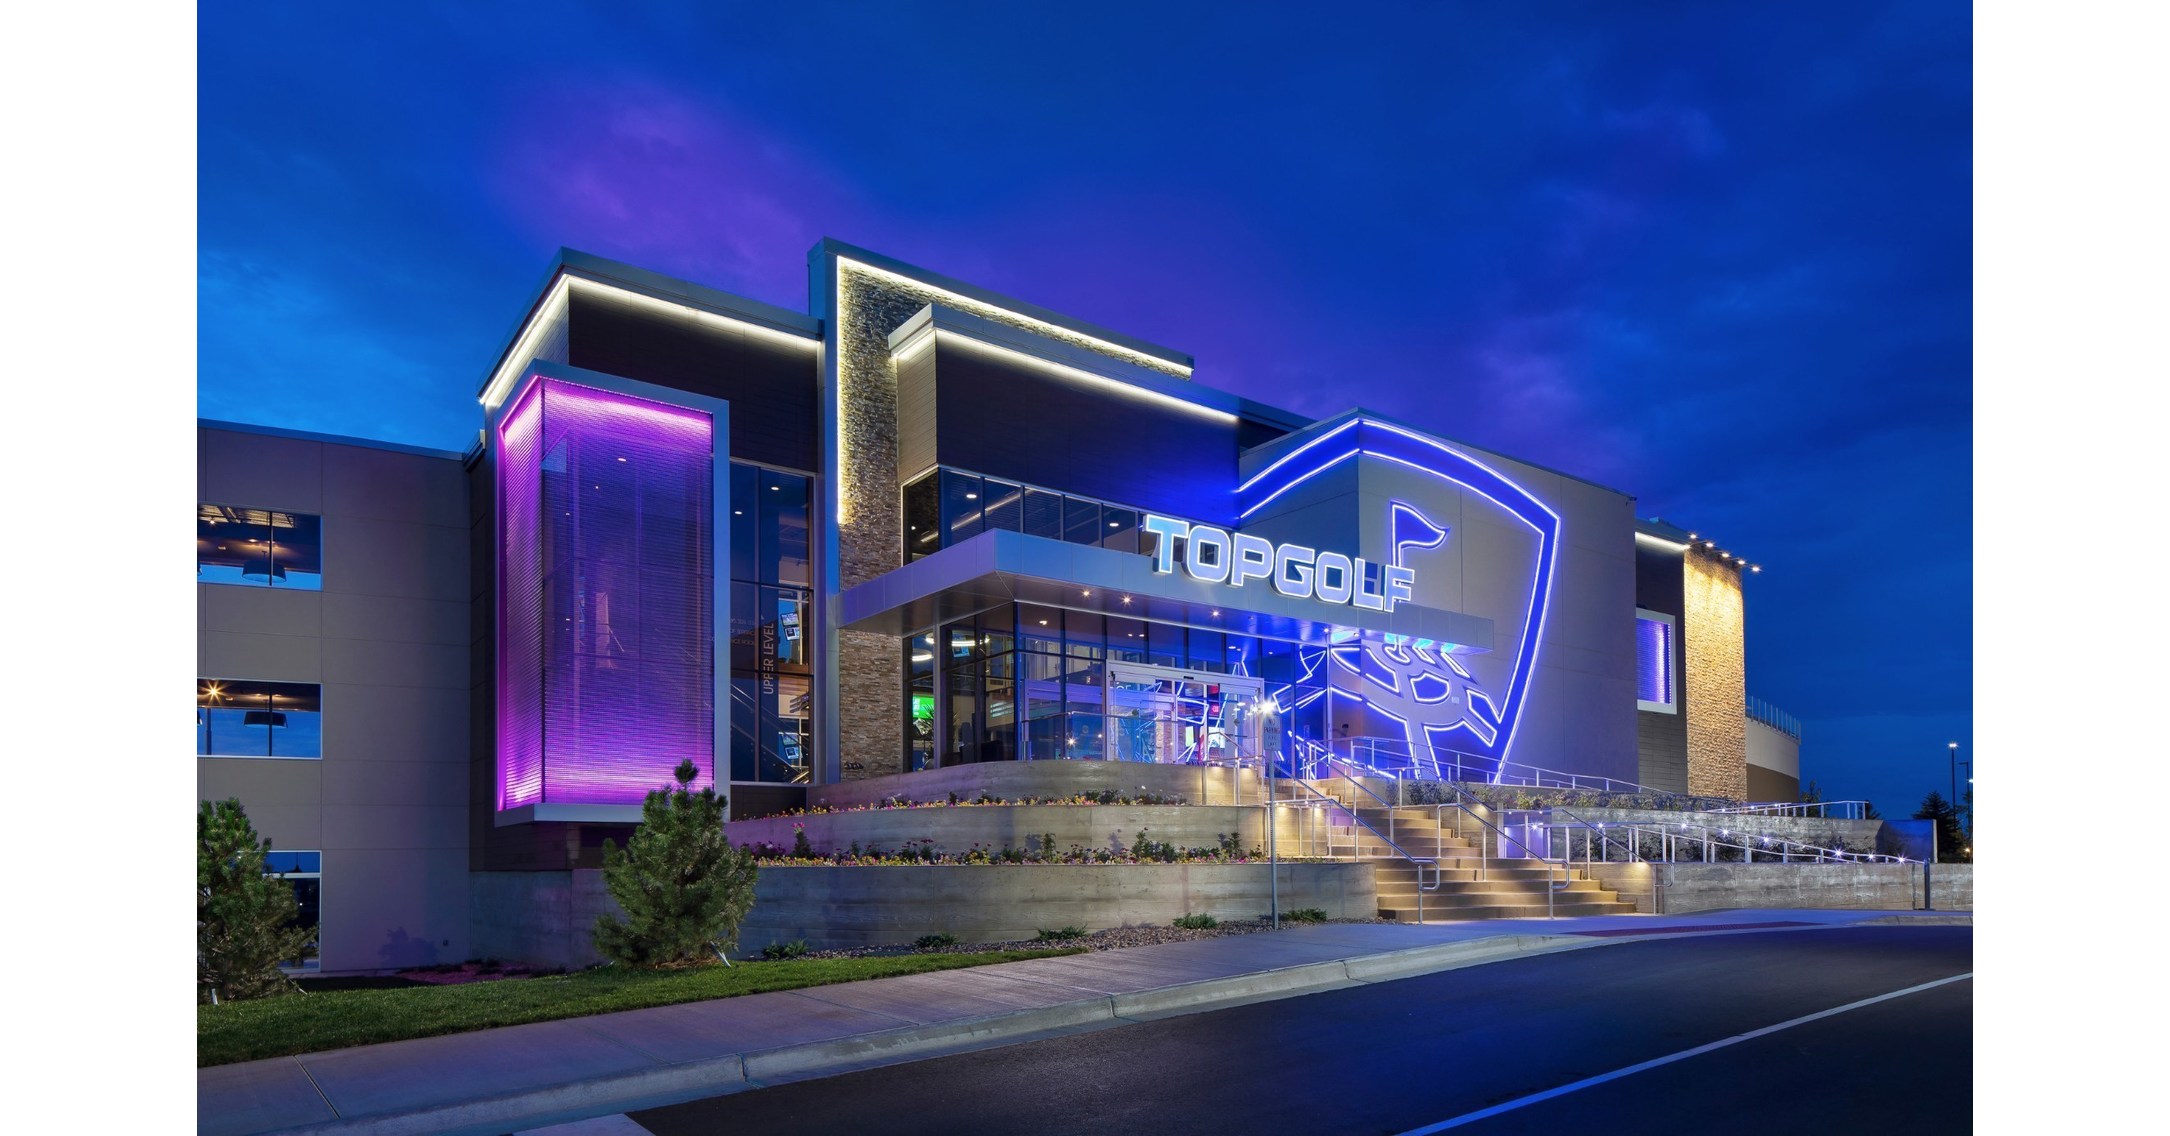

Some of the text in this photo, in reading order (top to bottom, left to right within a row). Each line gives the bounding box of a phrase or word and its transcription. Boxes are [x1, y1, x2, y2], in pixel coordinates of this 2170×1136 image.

[1144, 514, 1415, 612] TOPGOLF
[763, 623, 774, 695] UPPER LEVEL
